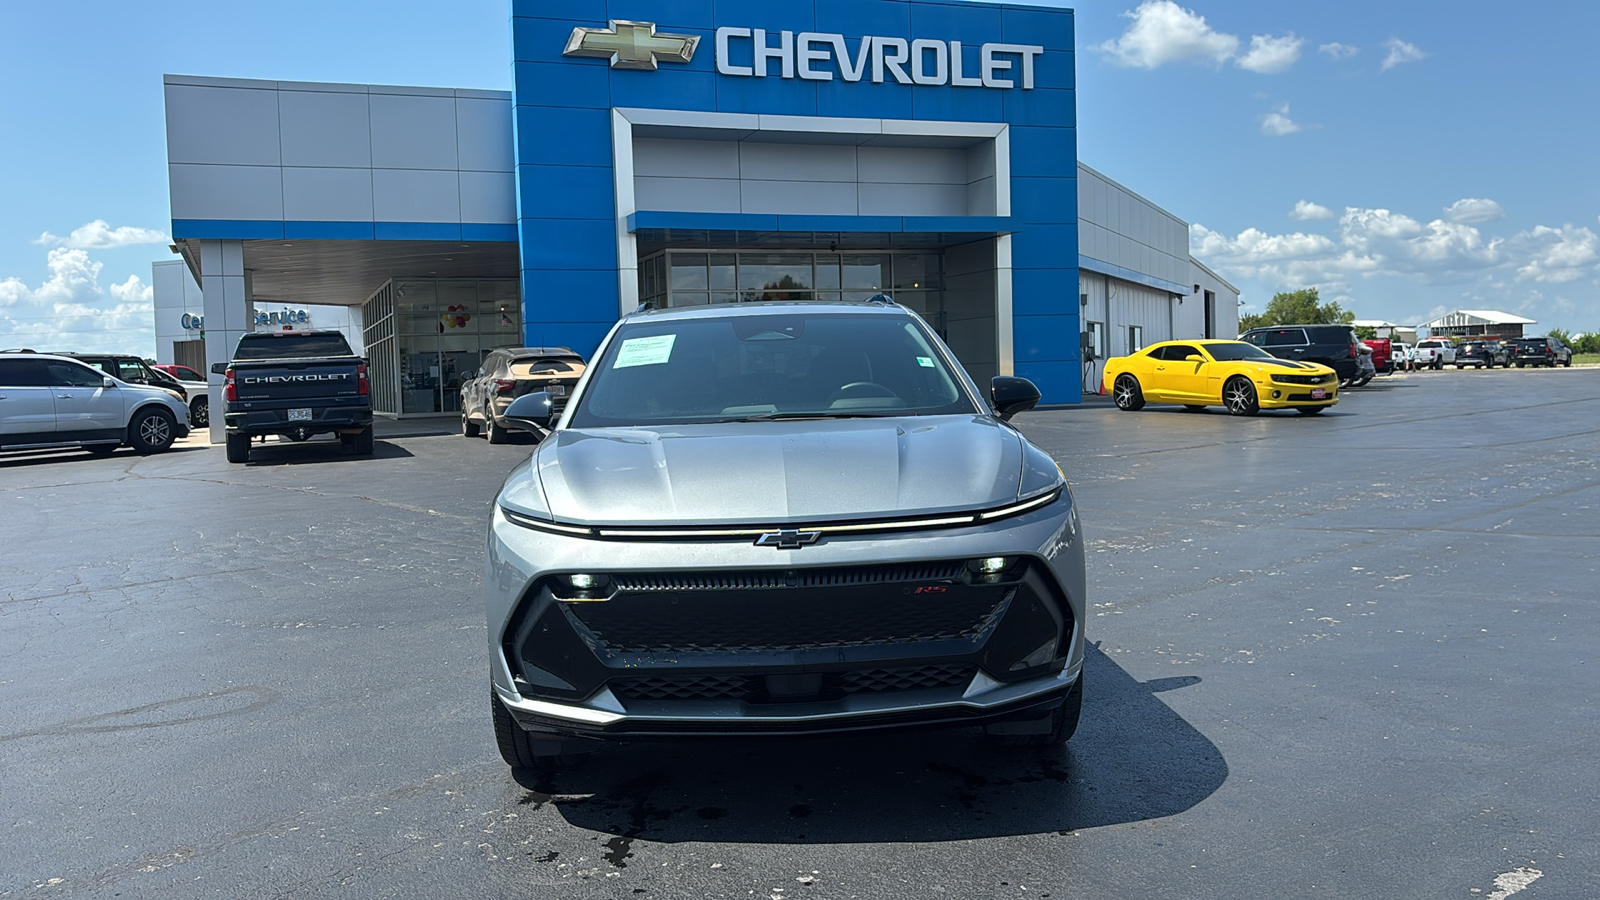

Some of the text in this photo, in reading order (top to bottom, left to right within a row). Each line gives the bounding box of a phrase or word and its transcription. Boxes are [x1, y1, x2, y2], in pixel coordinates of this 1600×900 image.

[715, 27, 1043, 90] CHEVROLET
[254, 307, 307, 325] Service
[244, 373, 350, 384] CHEVROLET
[914, 586, 948, 594] RS
